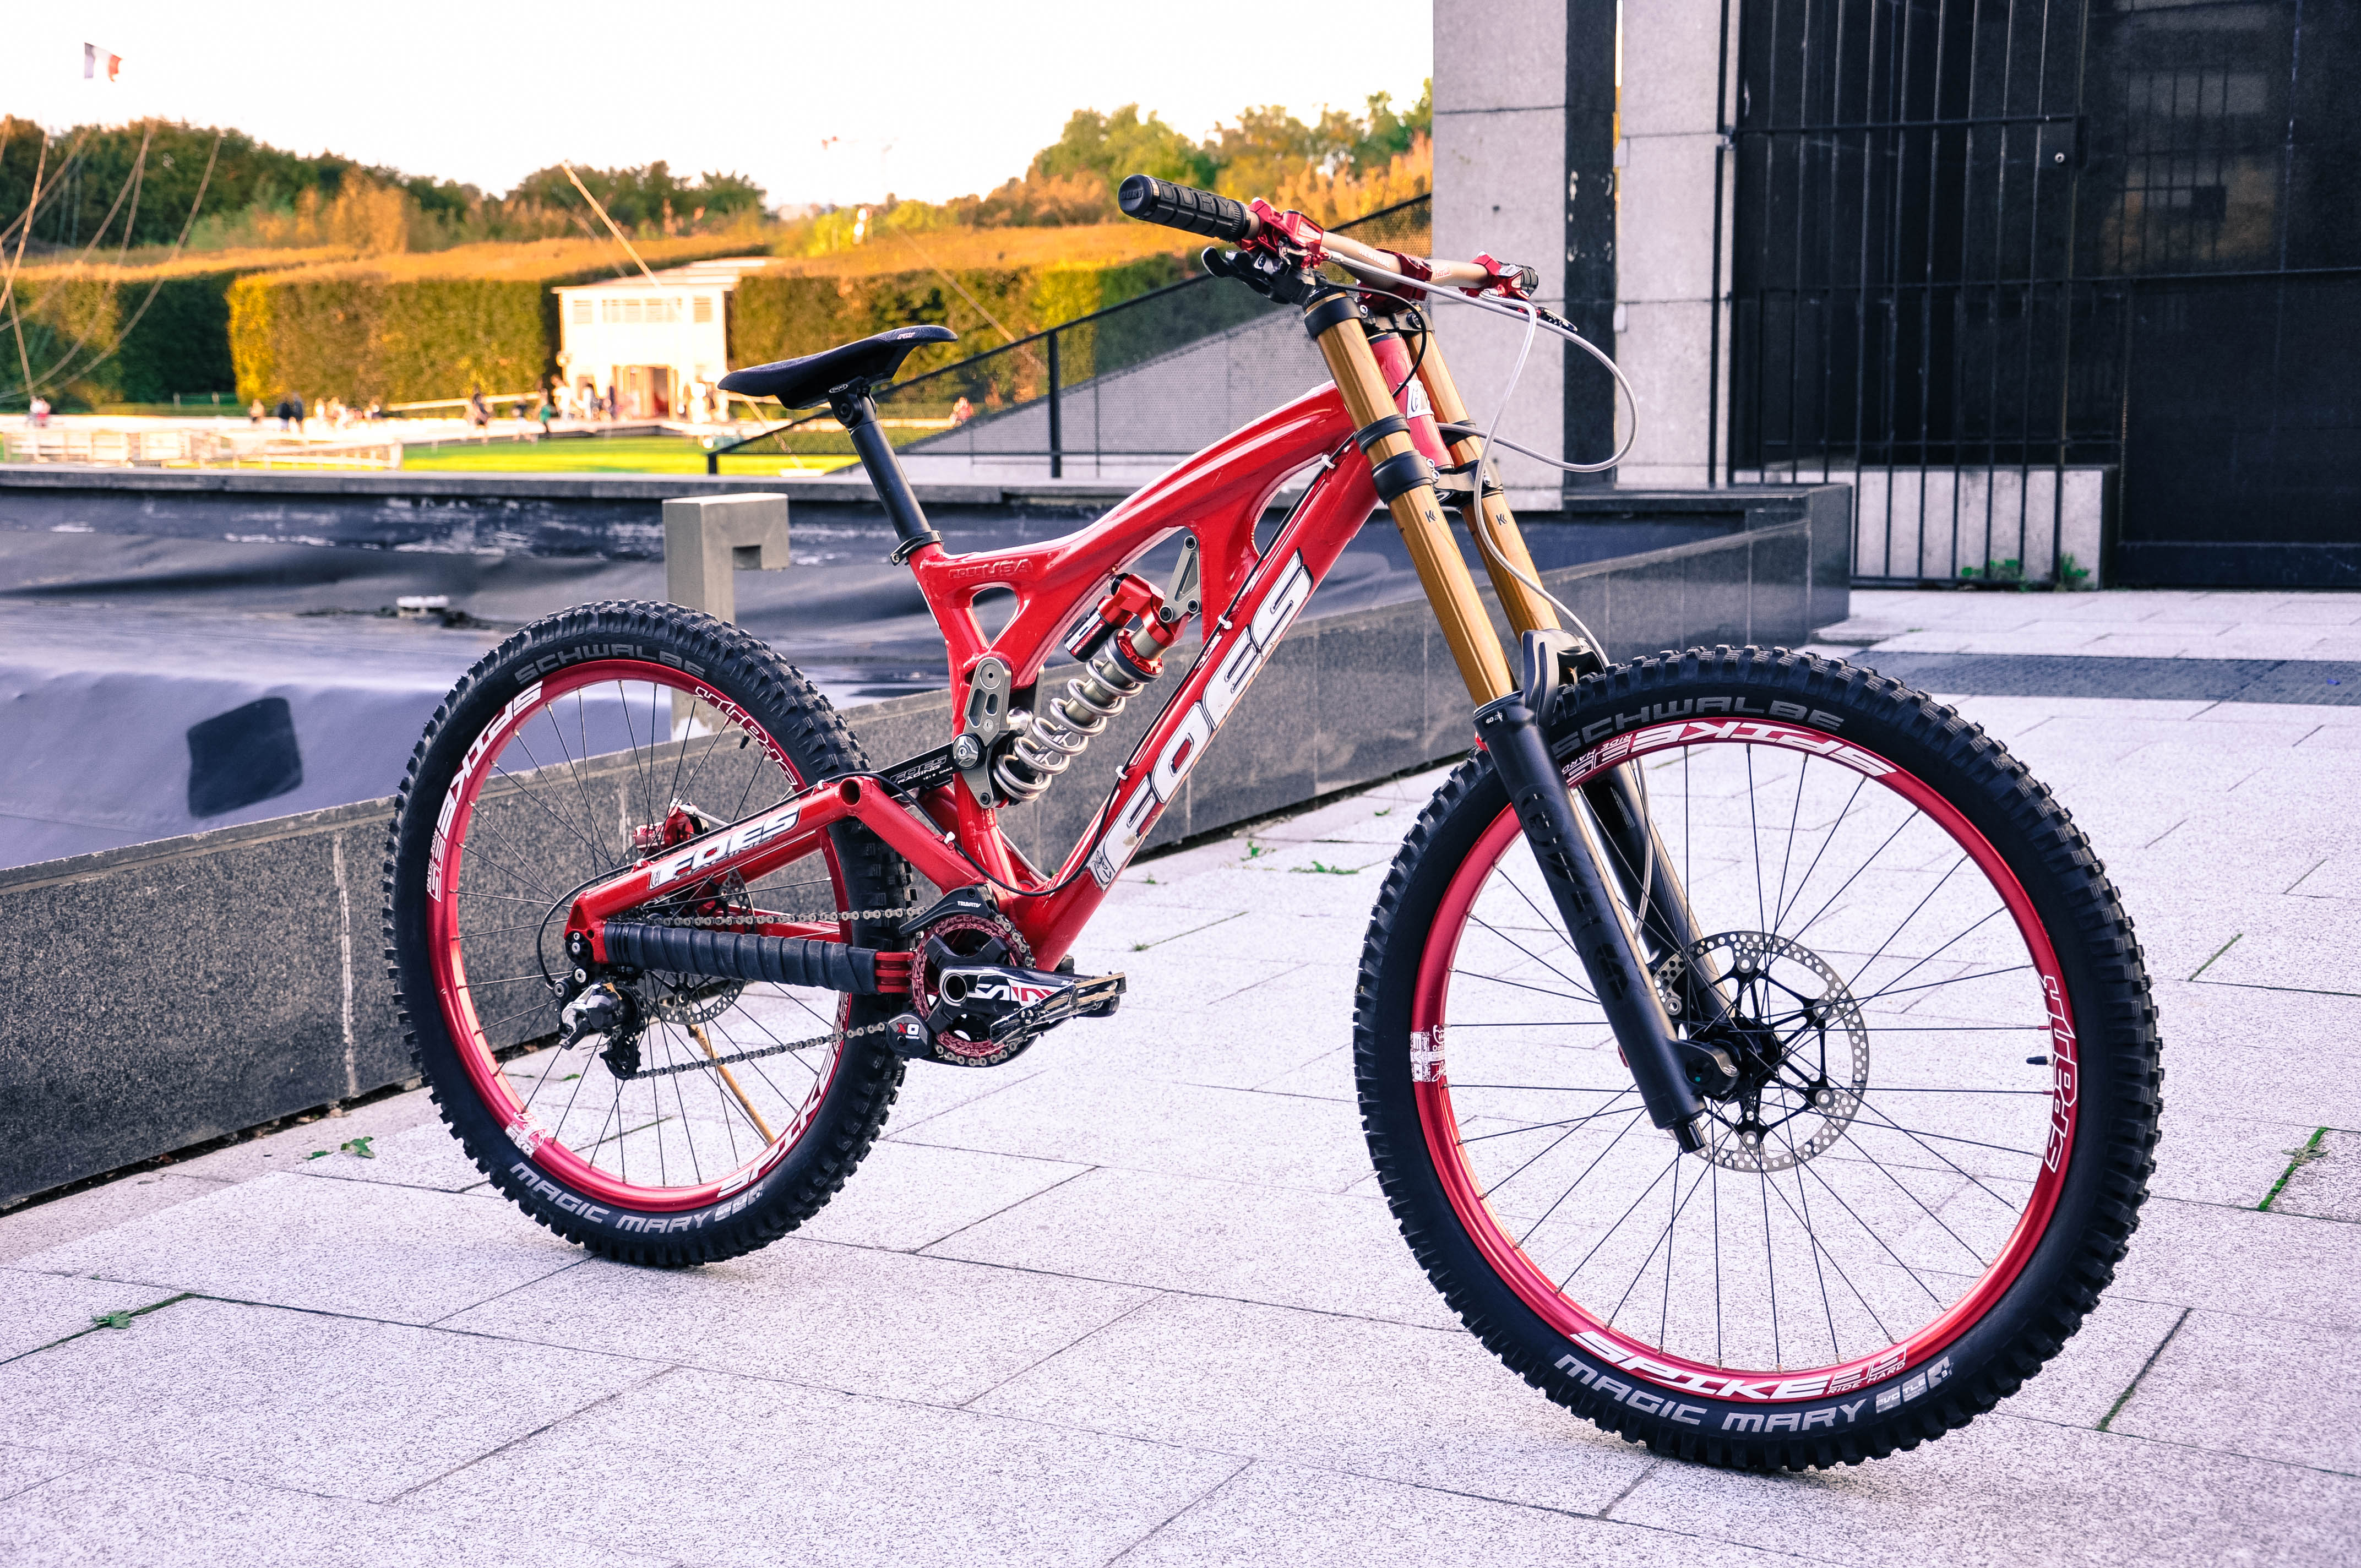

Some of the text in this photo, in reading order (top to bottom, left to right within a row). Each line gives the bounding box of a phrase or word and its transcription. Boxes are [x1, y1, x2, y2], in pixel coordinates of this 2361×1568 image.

[1120, 189, 1144, 200] OURY
[1161, 184, 1230, 215] OURY
[515, 643, 706, 685] SCHWALBE
[1103, 547, 1314, 873] FOES
[1550, 697, 1846, 759] SCHWALBE
[437, 680, 543, 840] SPIKE
[890, 755, 948, 783] FOES
[897, 765, 941, 784] RACING
[1562, 733, 1634, 773] RIDE HARD
[1631, 721, 1897, 777] SPIKE
[659, 806, 801, 881] FOES
[716, 1042, 837, 1199] SPIKE
[510, 1162, 714, 1234] MAGIC MARY
[1554, 1354, 1868, 1433] MAGIC MARY
[1569, 1331, 1832, 1400] SPIKE
[1826, 1362, 1906, 1395] RIDE HARD
[1875, 1393, 1901, 1406] EVO
